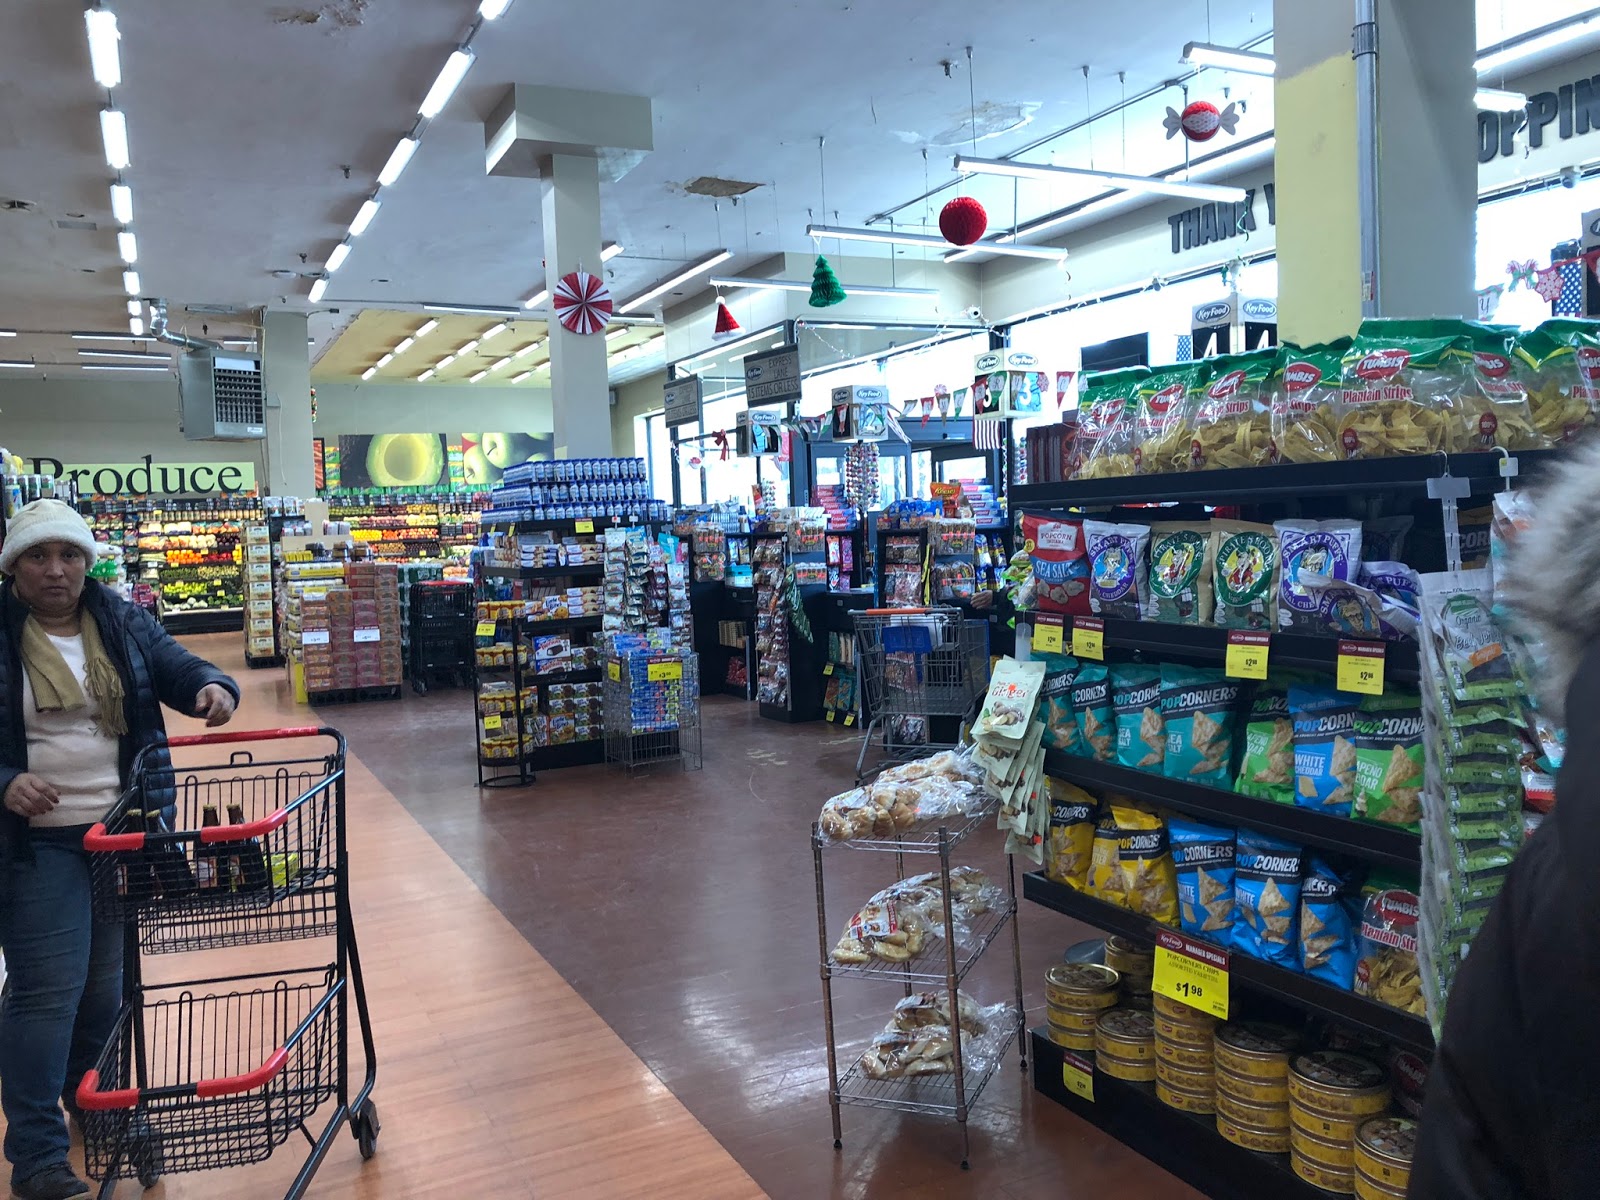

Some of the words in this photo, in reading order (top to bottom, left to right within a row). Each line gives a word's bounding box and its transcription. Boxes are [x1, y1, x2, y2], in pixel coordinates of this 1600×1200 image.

[1168, 188, 1257, 254] THANK
[1361, 355, 1405, 370] TUMBIS
[1343, 389, 1381, 403] Plantain
[1383, 386, 1413, 401] Strips
[1226, 400, 1250, 414] Strips
[27, 455, 243, 497] Produce
[1282, 534, 1322, 558] SMART
[1324, 535, 1345, 563] PUFFS
[1036, 560, 1051, 578] SEA
[1052, 562, 1075, 579] SALT
[1072, 684, 1107, 703] CORNERS
[1161, 687, 1238, 709] POPCORNERS
[1294, 753, 1326, 768] WHITE
[1294, 765, 1324, 776] CHEDDAR
[1383, 897, 1420, 917] TUMBIS
[1167, 952, 1202, 969] POPCORNERS
[1202, 963, 1220, 976] CHIPS
